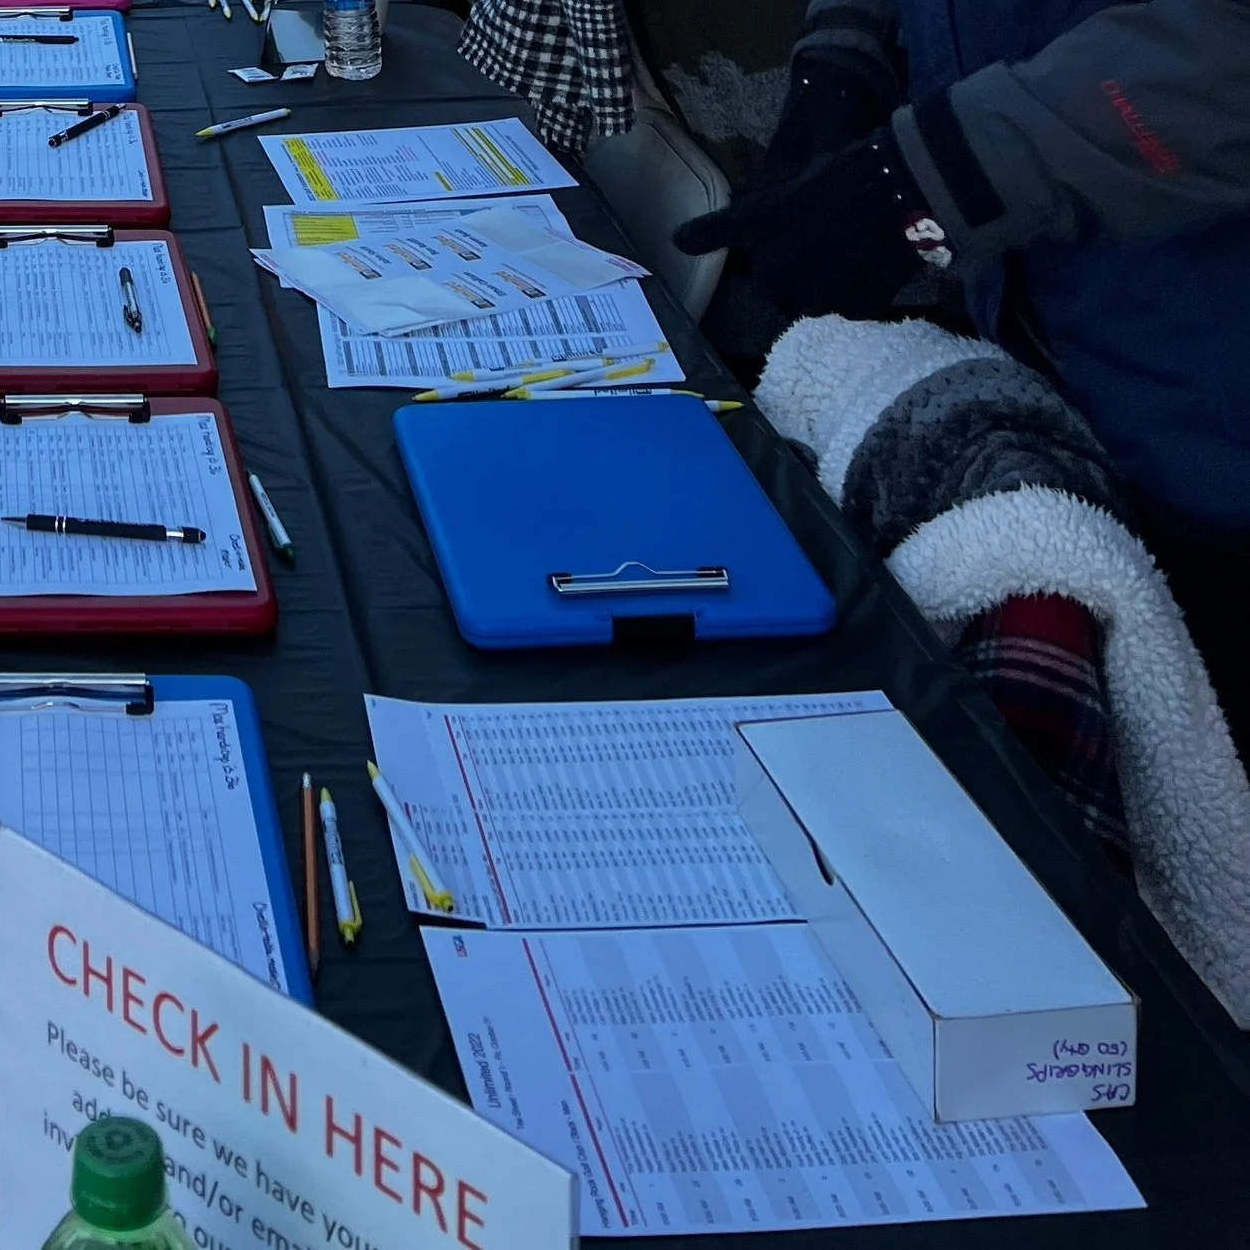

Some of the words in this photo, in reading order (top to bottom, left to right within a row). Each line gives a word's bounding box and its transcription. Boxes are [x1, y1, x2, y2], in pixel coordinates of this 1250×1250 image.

[467, 1032, 486, 1059] 2022
[45, 923, 222, 1084] CHECK
[242, 1041, 298, 1134] IN
[323, 1093, 488, 1250] HERE
[478, 1060, 502, 1109] Unlimited
[47, 1020, 115, 1087] Please
[122, 1069, 149, 1110] be
[155, 1099, 206, 1149] sure
[213, 1137, 249, 1178] we
[255, 1160, 316, 1223] have
[322, 1212, 379, 1250] you
[163, 1156, 244, 1225] and/or
